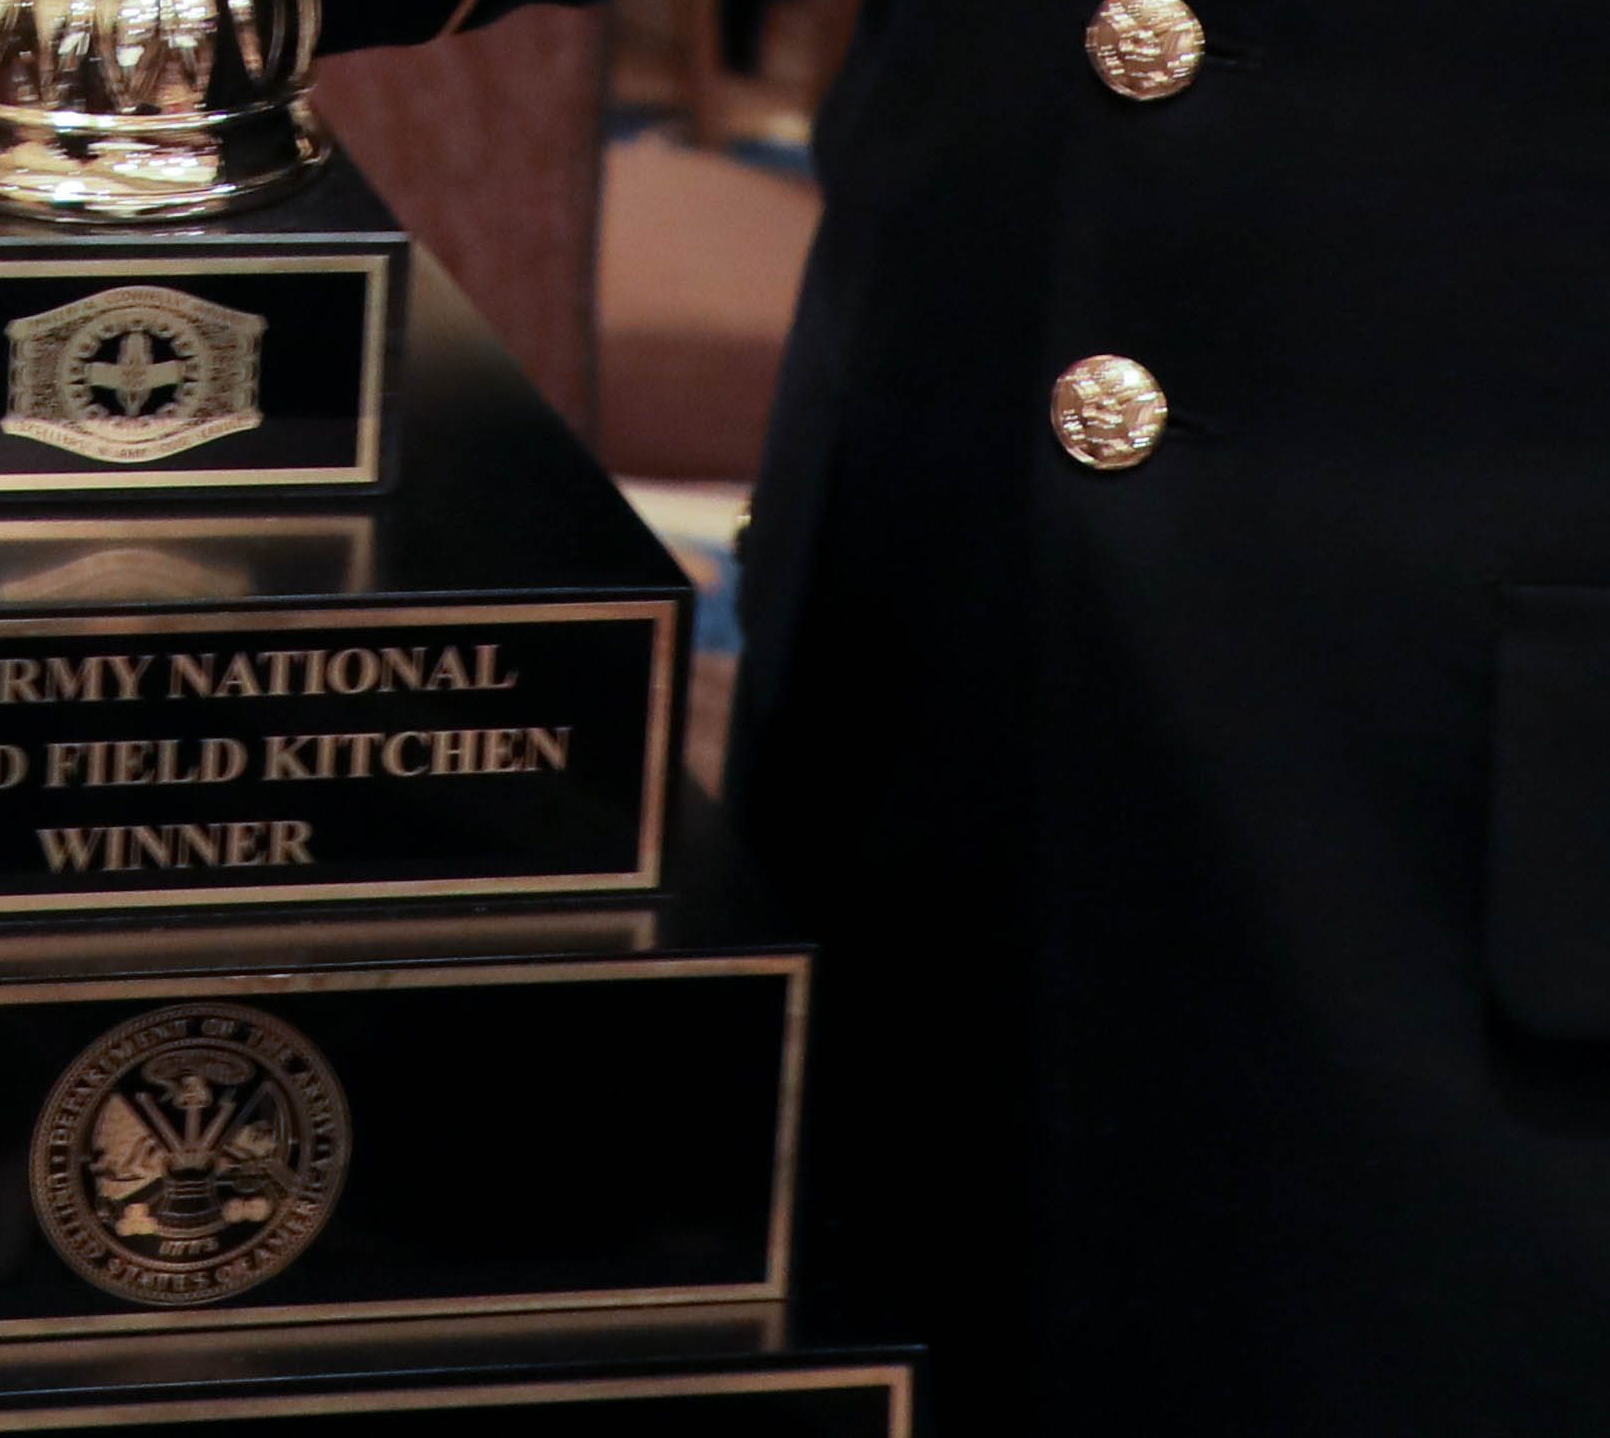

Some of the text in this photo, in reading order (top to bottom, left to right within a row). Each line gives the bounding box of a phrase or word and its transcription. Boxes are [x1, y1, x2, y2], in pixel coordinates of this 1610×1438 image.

[167, 644, 518, 699] NATIONAL
[42, 738, 249, 788] FIELD
[262, 727, 573, 781] KITCHEN
[37, 820, 316, 874] WINNER
